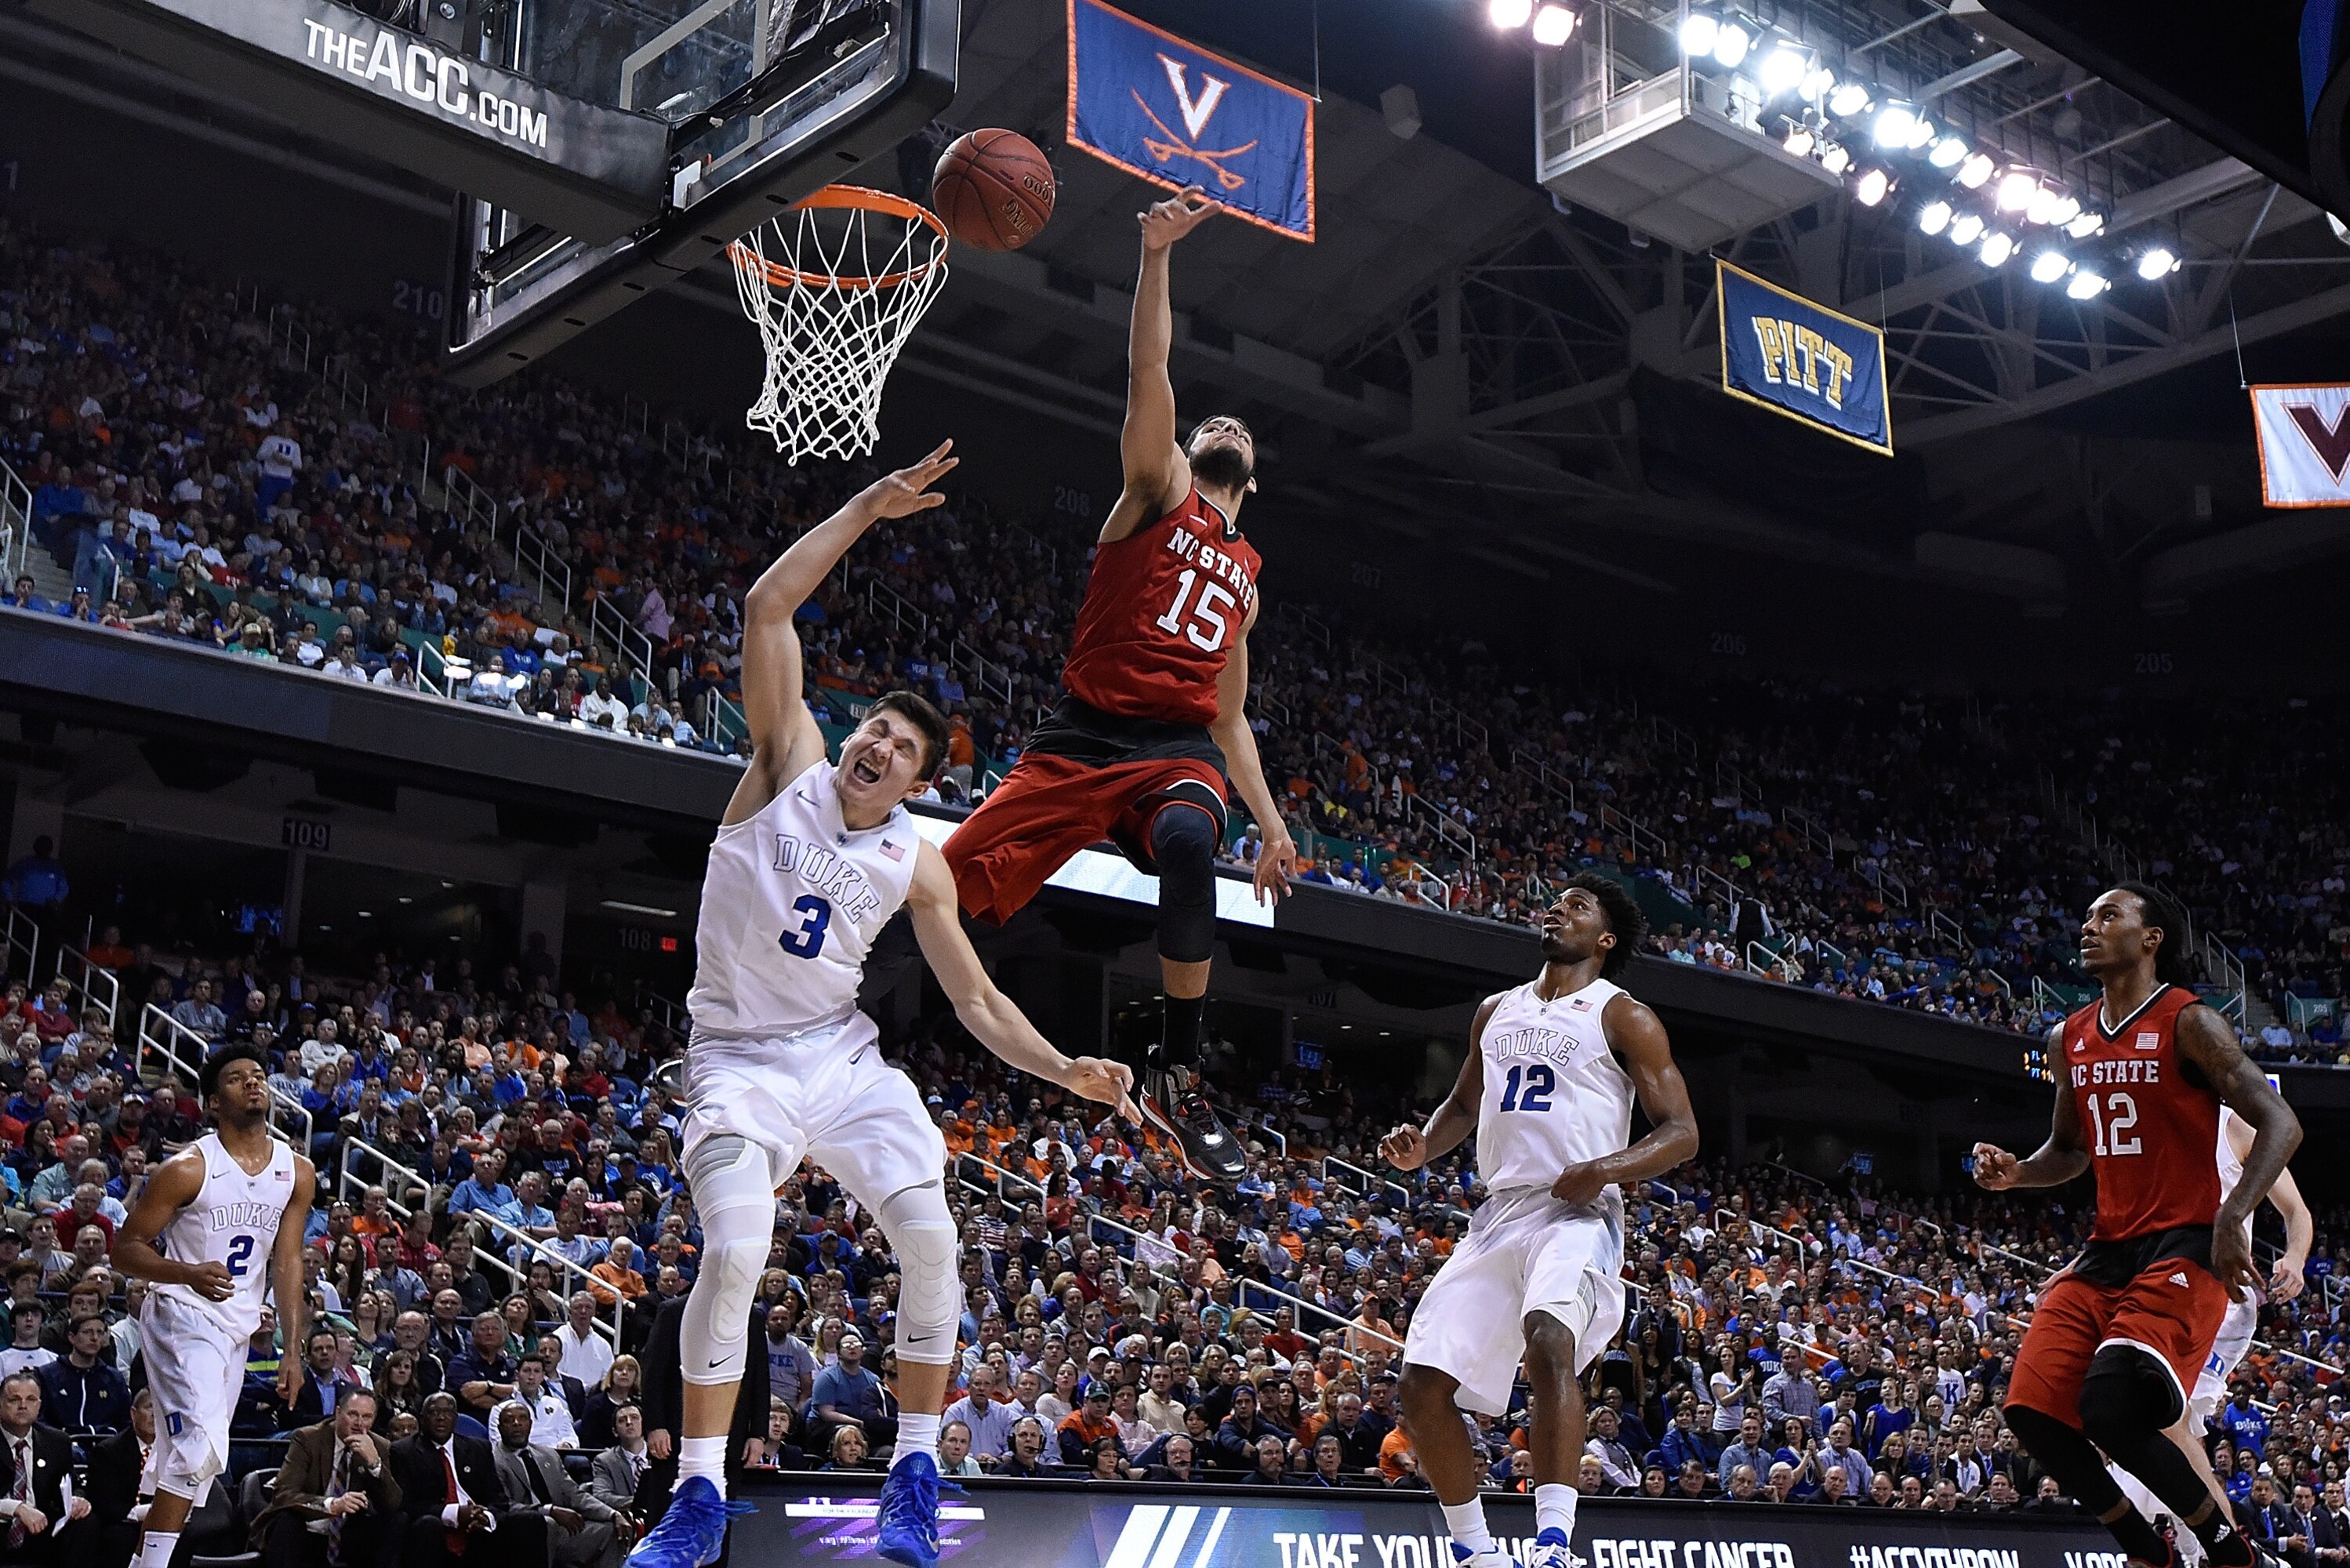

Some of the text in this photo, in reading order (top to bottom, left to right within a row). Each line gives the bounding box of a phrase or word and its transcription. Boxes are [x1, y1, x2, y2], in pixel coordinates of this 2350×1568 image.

[1156, 53, 1233, 143] V
[393, 279, 445, 320] 210
[1752, 316, 1853, 412] PITT
[1167, 527, 1255, 611] NC STATE
[1157, 568, 1226, 652] 15
[1711, 632, 1746, 657] 206
[2133, 652, 2174, 673] 205
[285, 820, 327, 848] 109
[773, 833, 881, 925] DUKE
[618, 927, 651, 951] 108
[778, 894, 833, 960] 3
[1495, 1027, 1580, 1067] DUKE
[1500, 1064, 1556, 1112] 12
[2092, 1060, 2159, 1083] STATE
[2087, 1093, 2142, 1156] 12
[210, 1202, 283, 1233] DUKE
[227, 1235, 255, 1276] 2
[1945, 1383, 1960, 1405] K
[2235, 1417, 2263, 1432] DUKE
[1273, 1533, 1364, 1568] TAKE
[1592, 1539, 1676, 1568] FIGHT
[1684, 1541, 1796, 1568] CANCER
